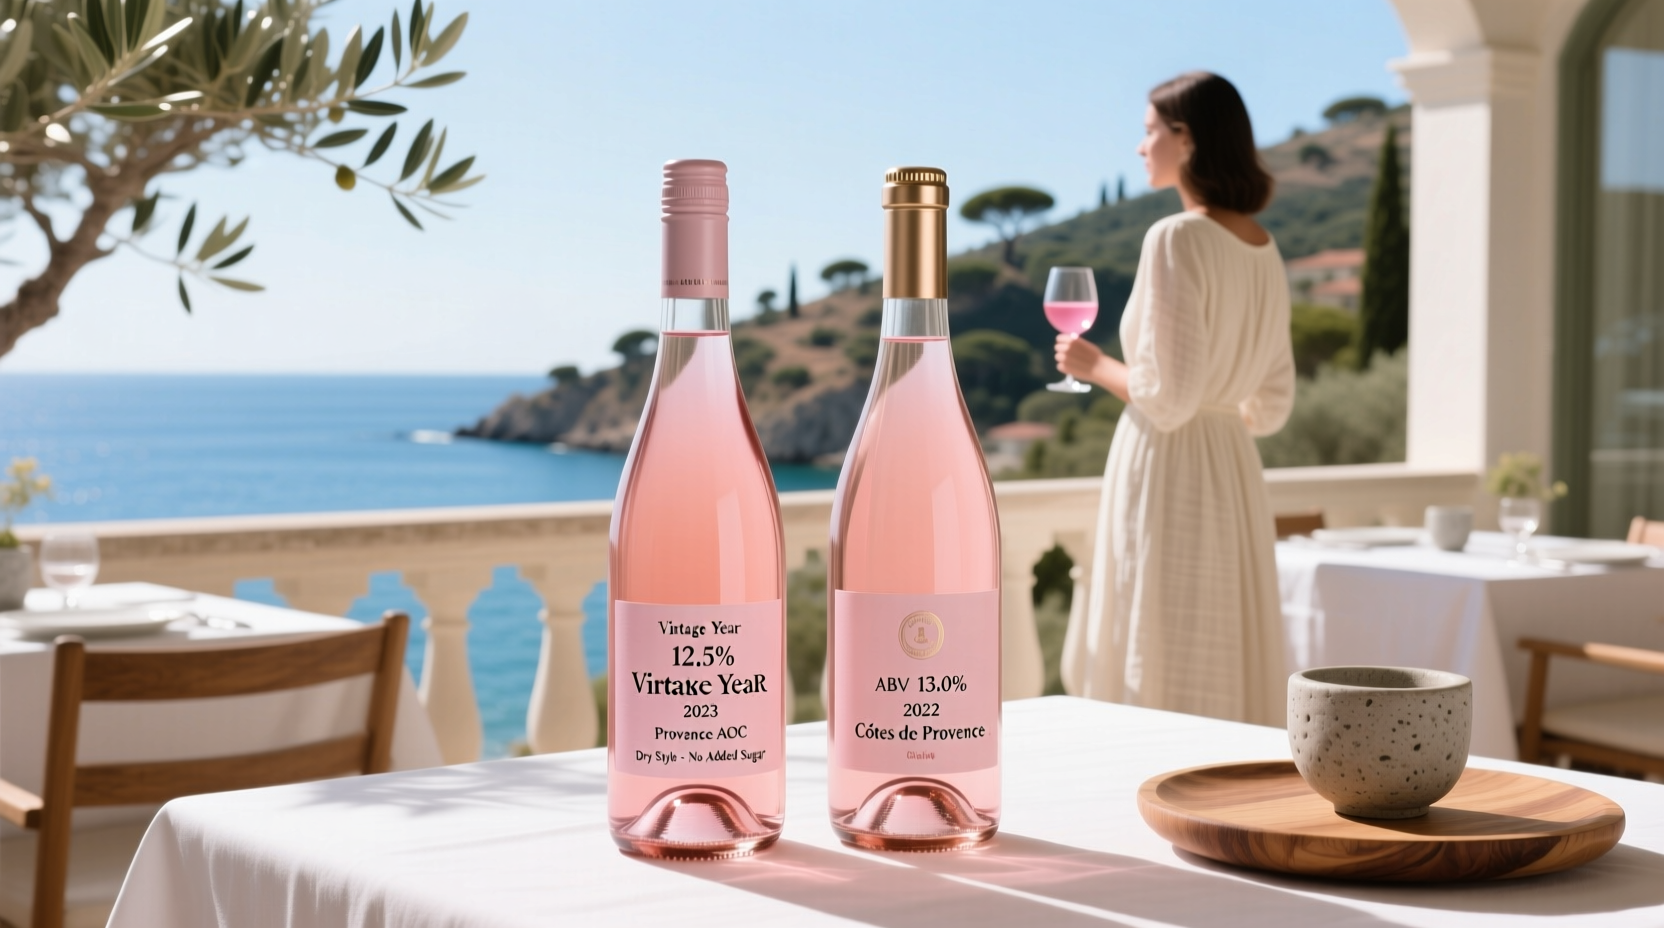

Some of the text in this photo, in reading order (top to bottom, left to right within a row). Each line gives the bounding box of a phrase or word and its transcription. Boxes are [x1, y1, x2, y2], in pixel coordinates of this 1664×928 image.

[711, 620, 742, 635] Year
[672, 645, 735, 667] 12.5%
[874, 674, 967, 693] ABV 13.0%
[683, 704, 719, 718] 2023
[903, 702, 940, 718] 2022
[716, 725, 748, 740] AOC
[922, 725, 986, 741] Provence
[635, 749, 653, 765] Dry
[688, 751, 704, 763] No
